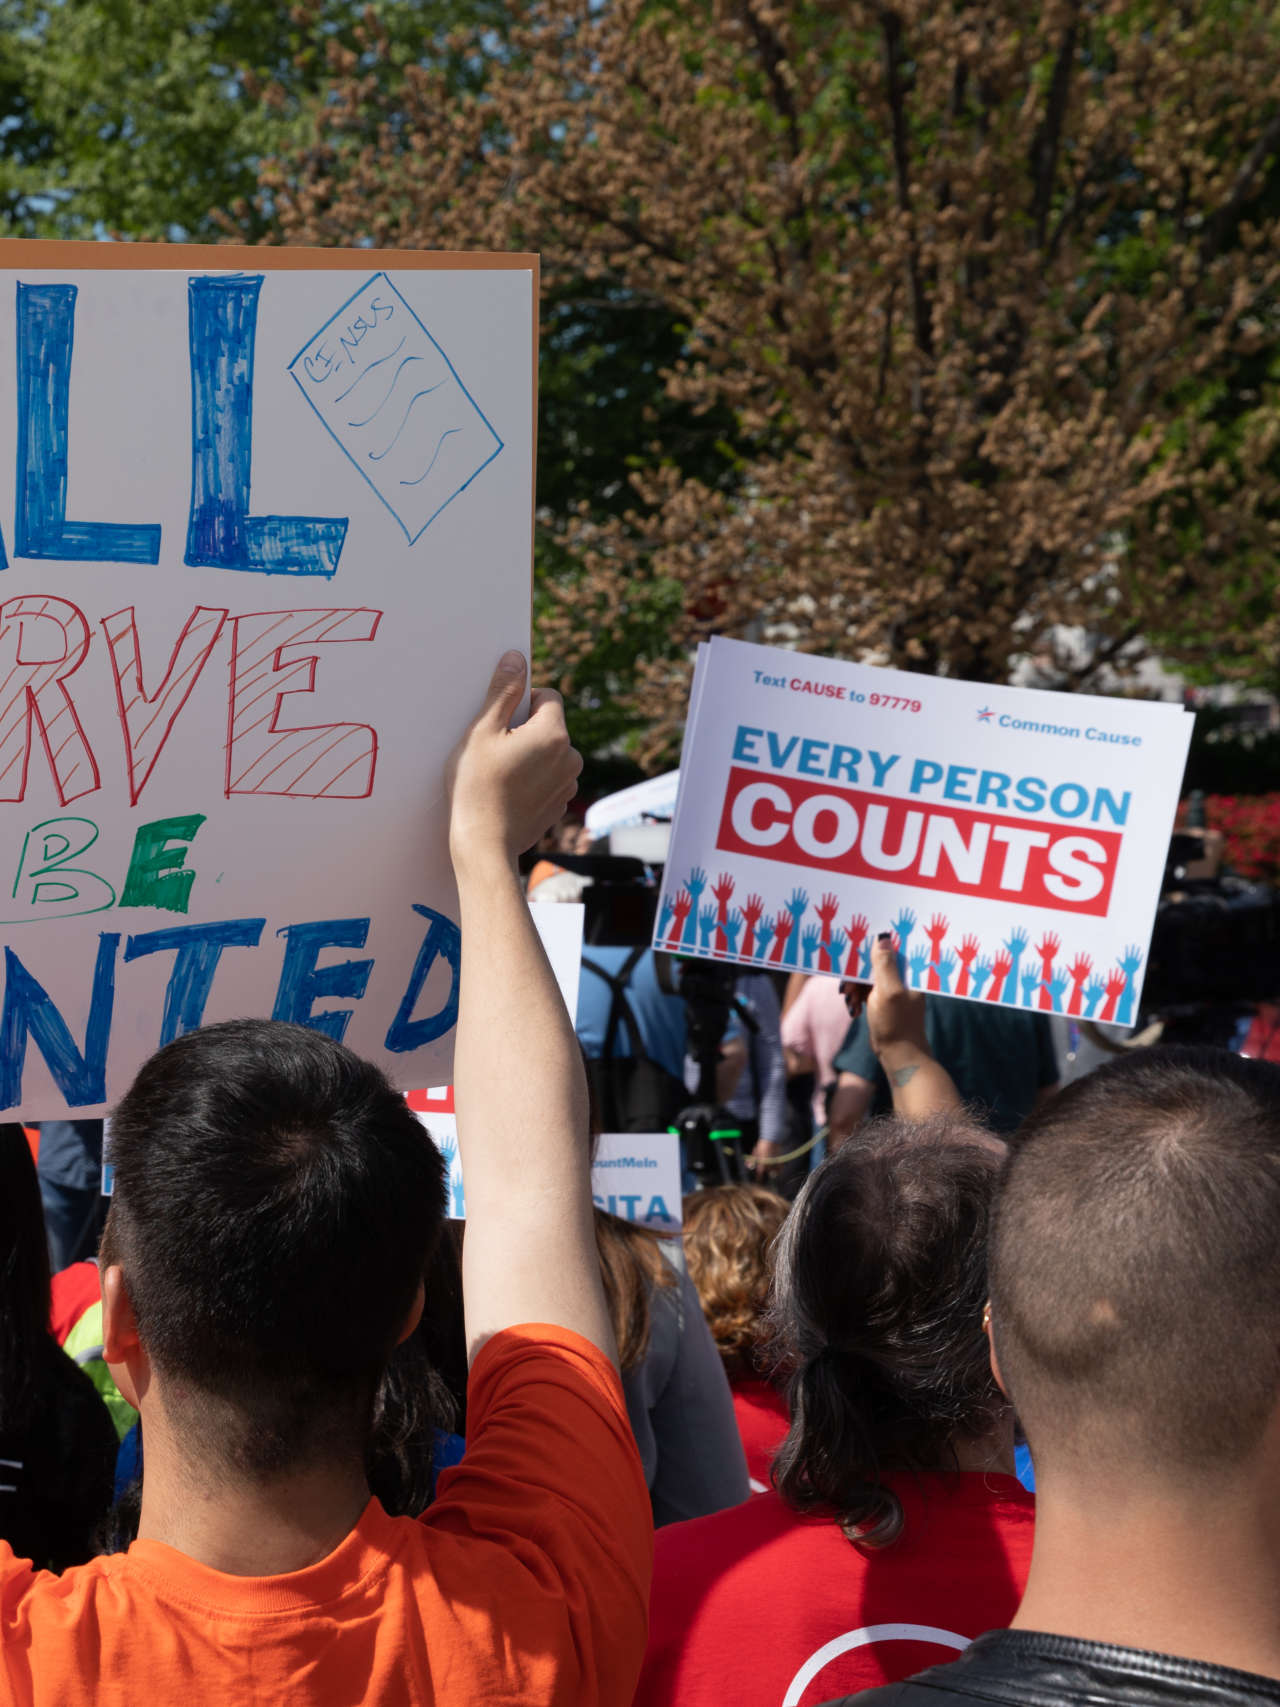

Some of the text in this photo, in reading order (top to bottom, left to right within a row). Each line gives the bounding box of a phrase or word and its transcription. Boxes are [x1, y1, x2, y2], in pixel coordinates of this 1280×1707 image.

[303, 296, 394, 383] CENSUS
[753, 670, 922, 713] Text CAUSE to 97779
[998, 714, 1143, 747] Common Cause
[731, 725, 1132, 826] EVERY PERSON
[730, 783, 1108, 902] COUNTS
